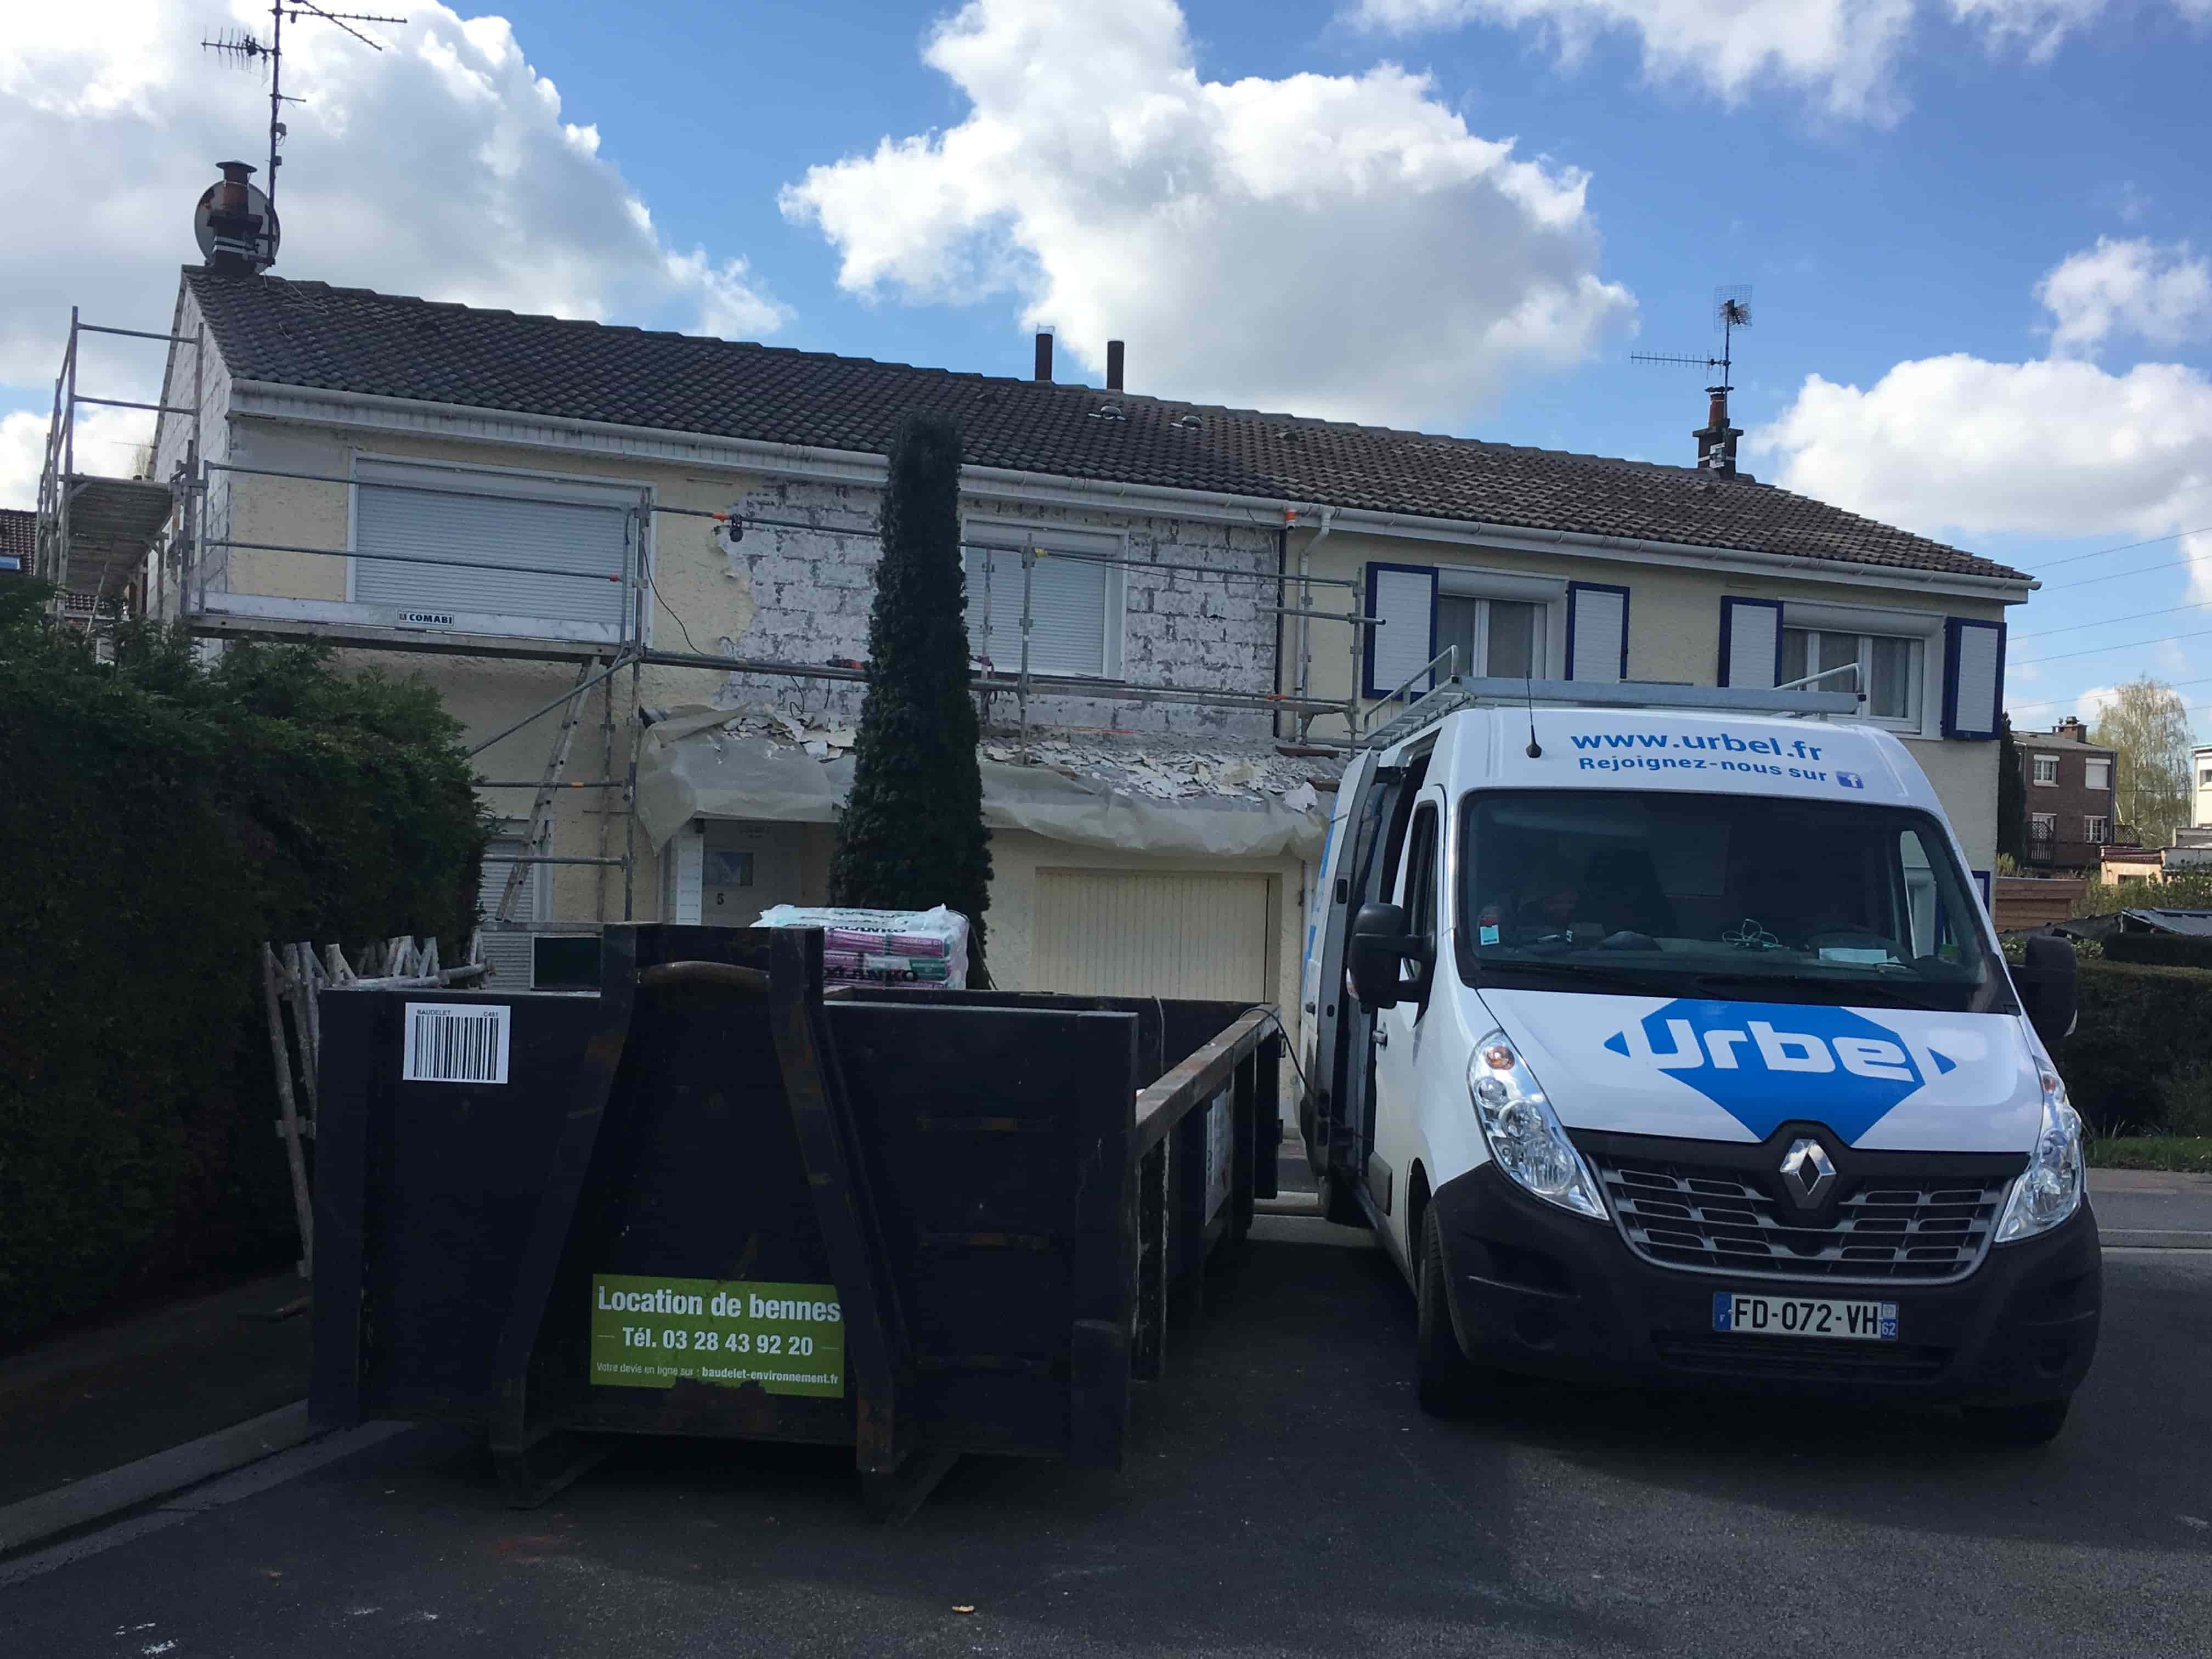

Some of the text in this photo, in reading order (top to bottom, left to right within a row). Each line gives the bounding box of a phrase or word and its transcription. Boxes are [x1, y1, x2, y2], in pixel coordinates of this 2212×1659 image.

[409, 614, 453, 624] COMABI
[1571, 733, 1822, 761] www.urbel.fr
[1578, 757, 1783, 776] Rejoignez-nous
[1789, 768, 1827, 782] sur
[717, 893, 725, 905] 5
[598, 1285, 842, 1322] Location de bennes
[1735, 1298, 1878, 1334] FD-072-VH
[1882, 1322, 1896, 1336] 62
[622, 1326, 813, 1356] Tél. 03 28 43 92 20
[596, 1362, 618, 1372] Votre
[620, 1363, 642, 1374] devis
[645, 1365, 654, 1374] en
[657, 1365, 678, 1377] ligne
[680, 1368, 694, 1376] sur
[702, 1366, 839, 1384] baudelet-environnement.fr
